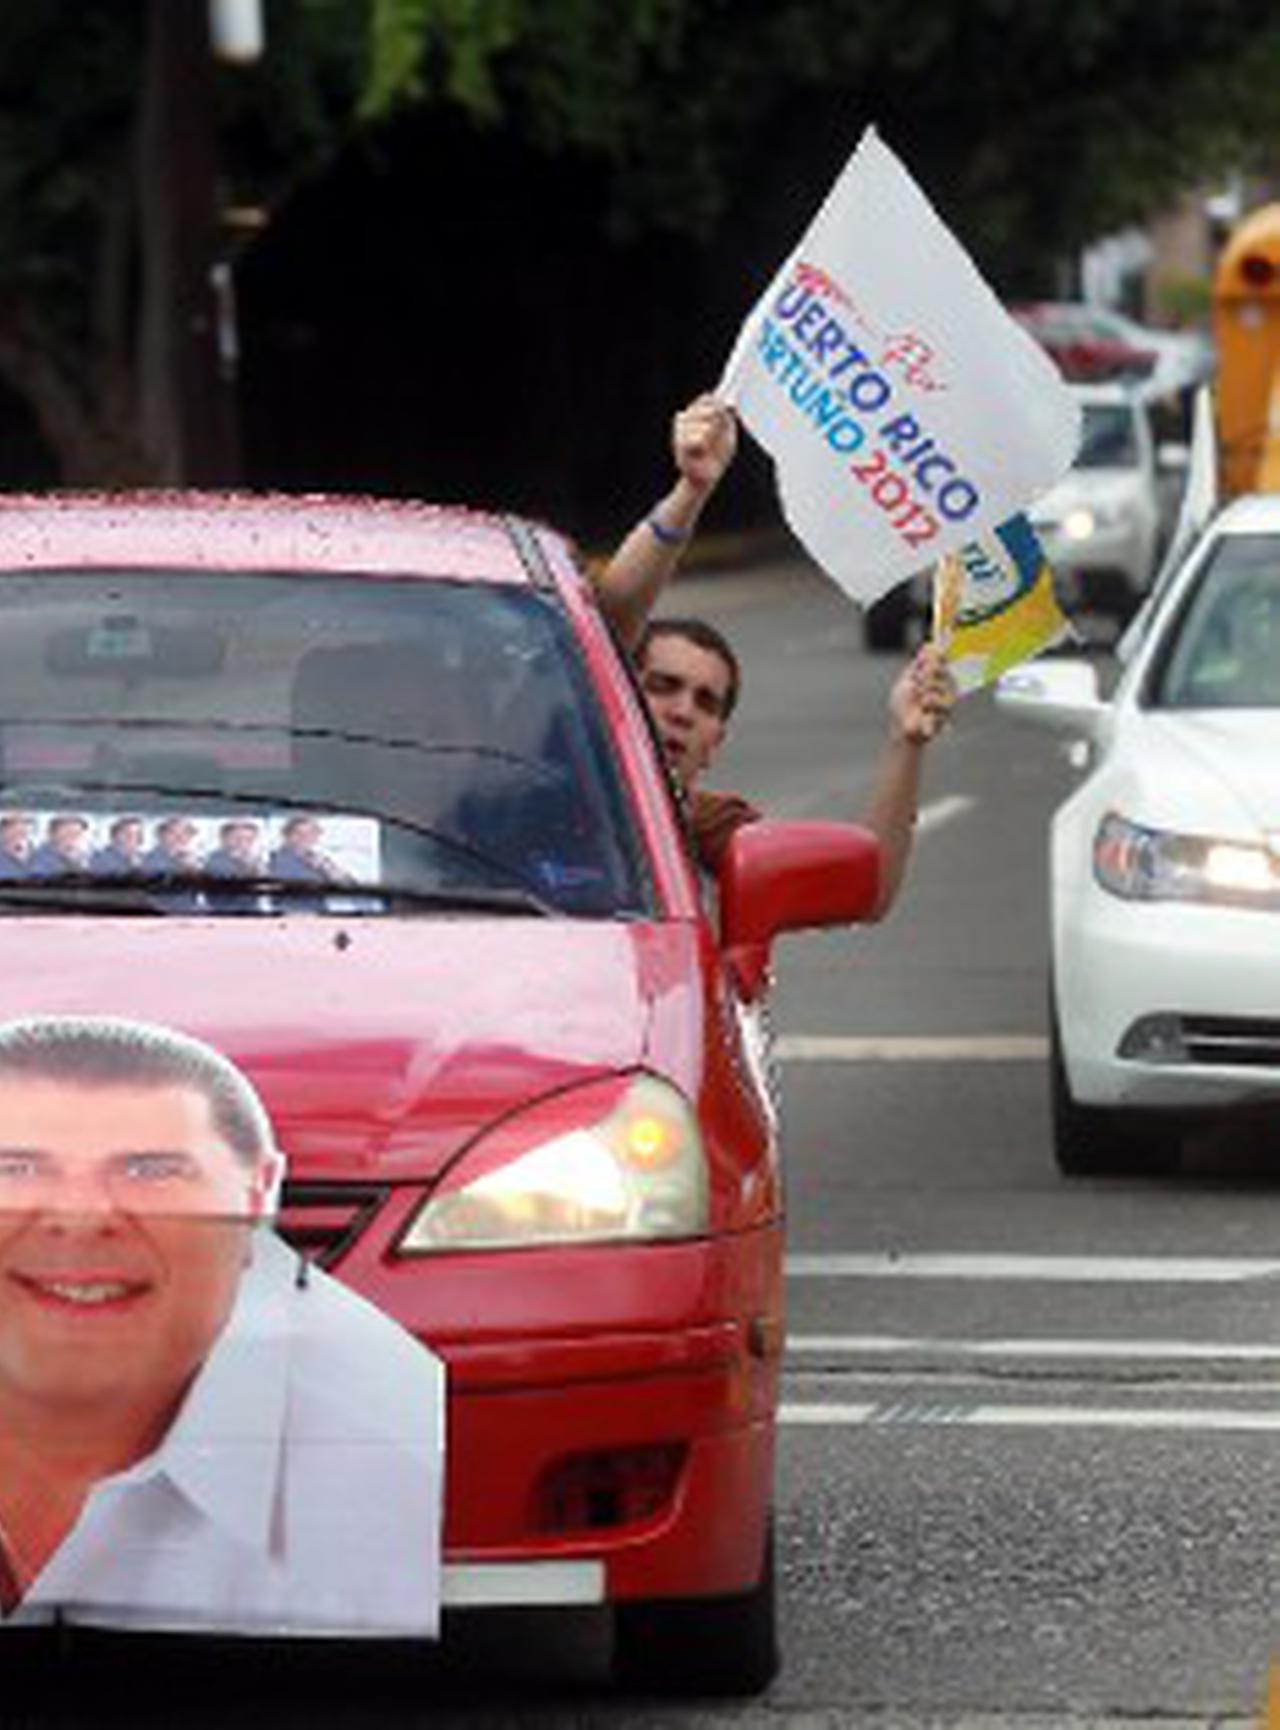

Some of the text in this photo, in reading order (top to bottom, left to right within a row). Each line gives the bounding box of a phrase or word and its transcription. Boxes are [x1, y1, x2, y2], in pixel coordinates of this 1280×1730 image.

[774, 284, 979, 522] UERTO RICO
[850, 450, 940, 548] 2012
